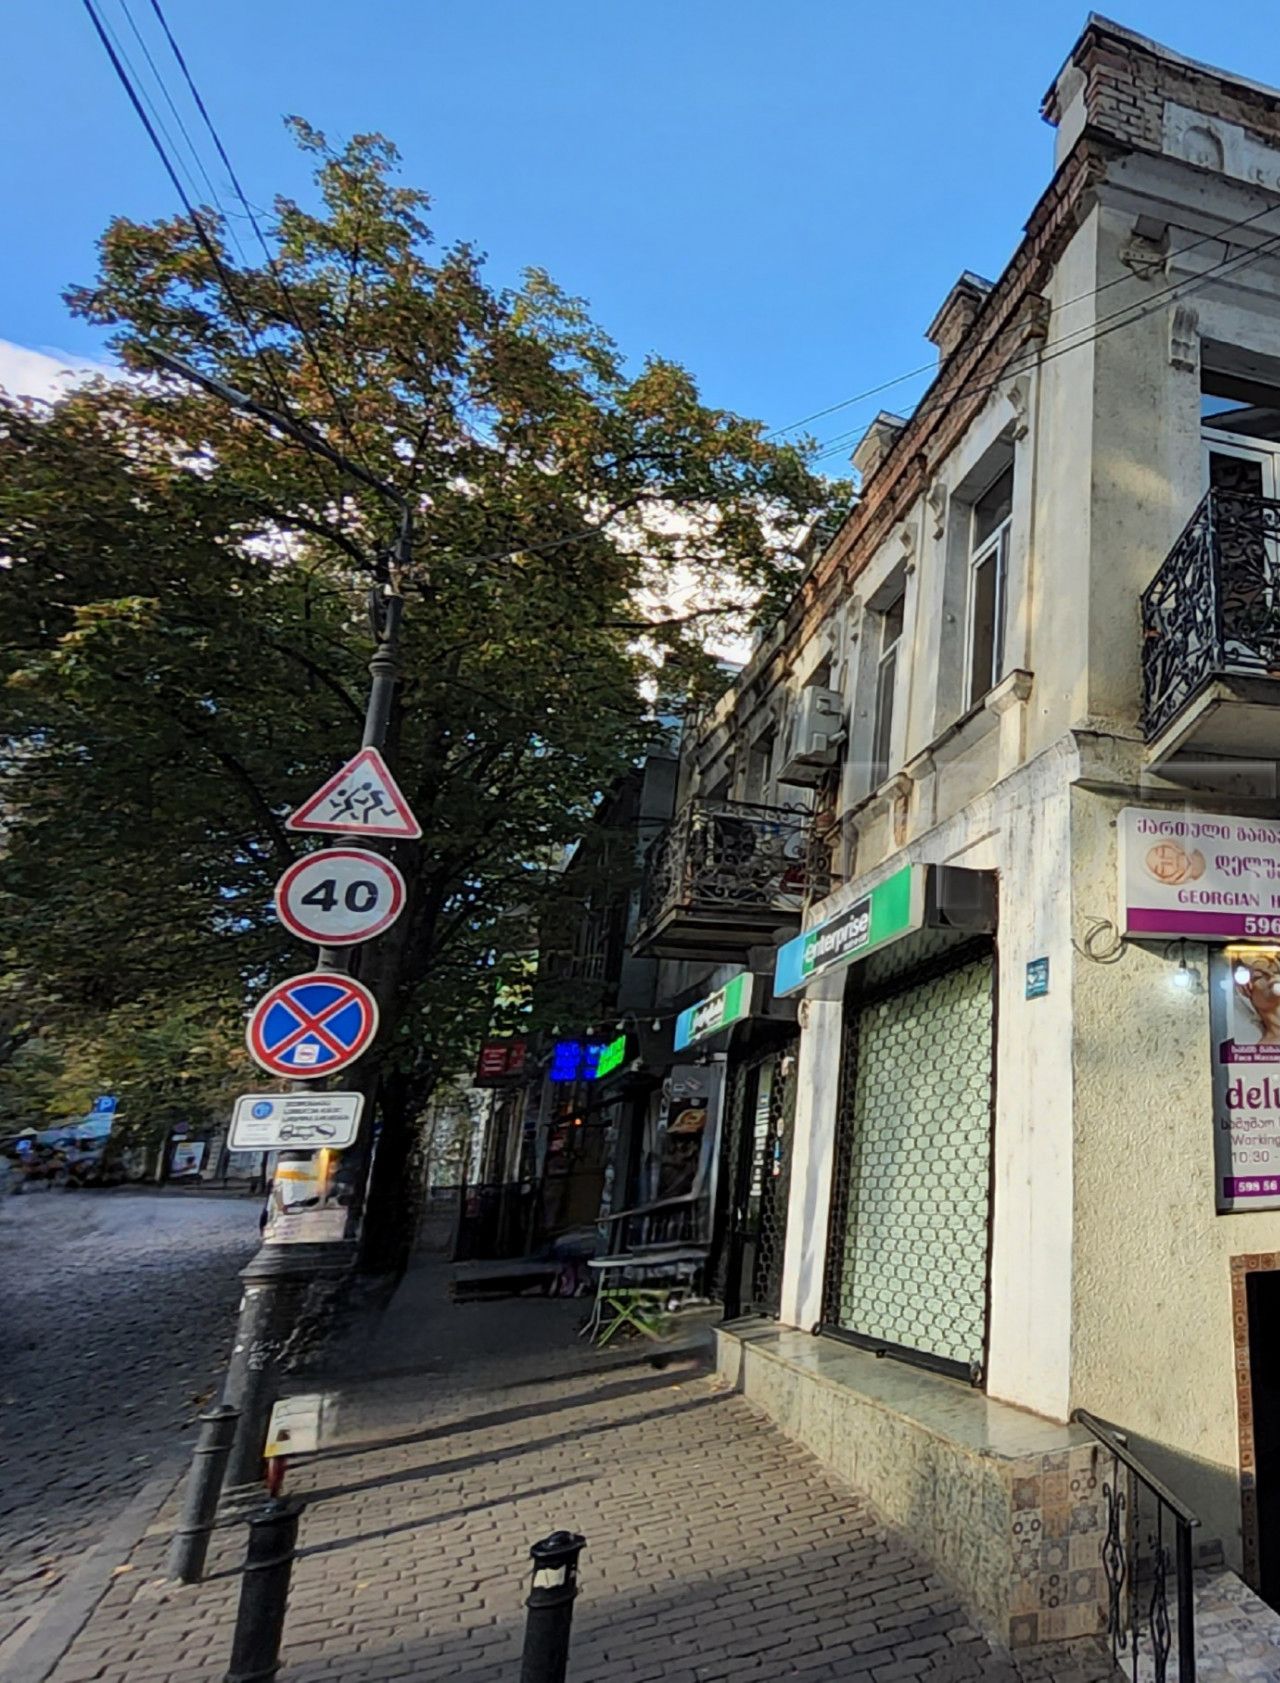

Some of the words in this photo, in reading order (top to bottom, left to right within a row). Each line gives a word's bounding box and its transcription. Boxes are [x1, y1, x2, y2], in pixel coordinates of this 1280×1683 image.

[1137, 818, 1231, 839] ქართული
[301, 878, 379, 913] 40
[1178, 889, 1260, 907] GEORGIAN
[804, 912, 869, 962] enterprise
[1231, 1134, 1280, 1148] Working
